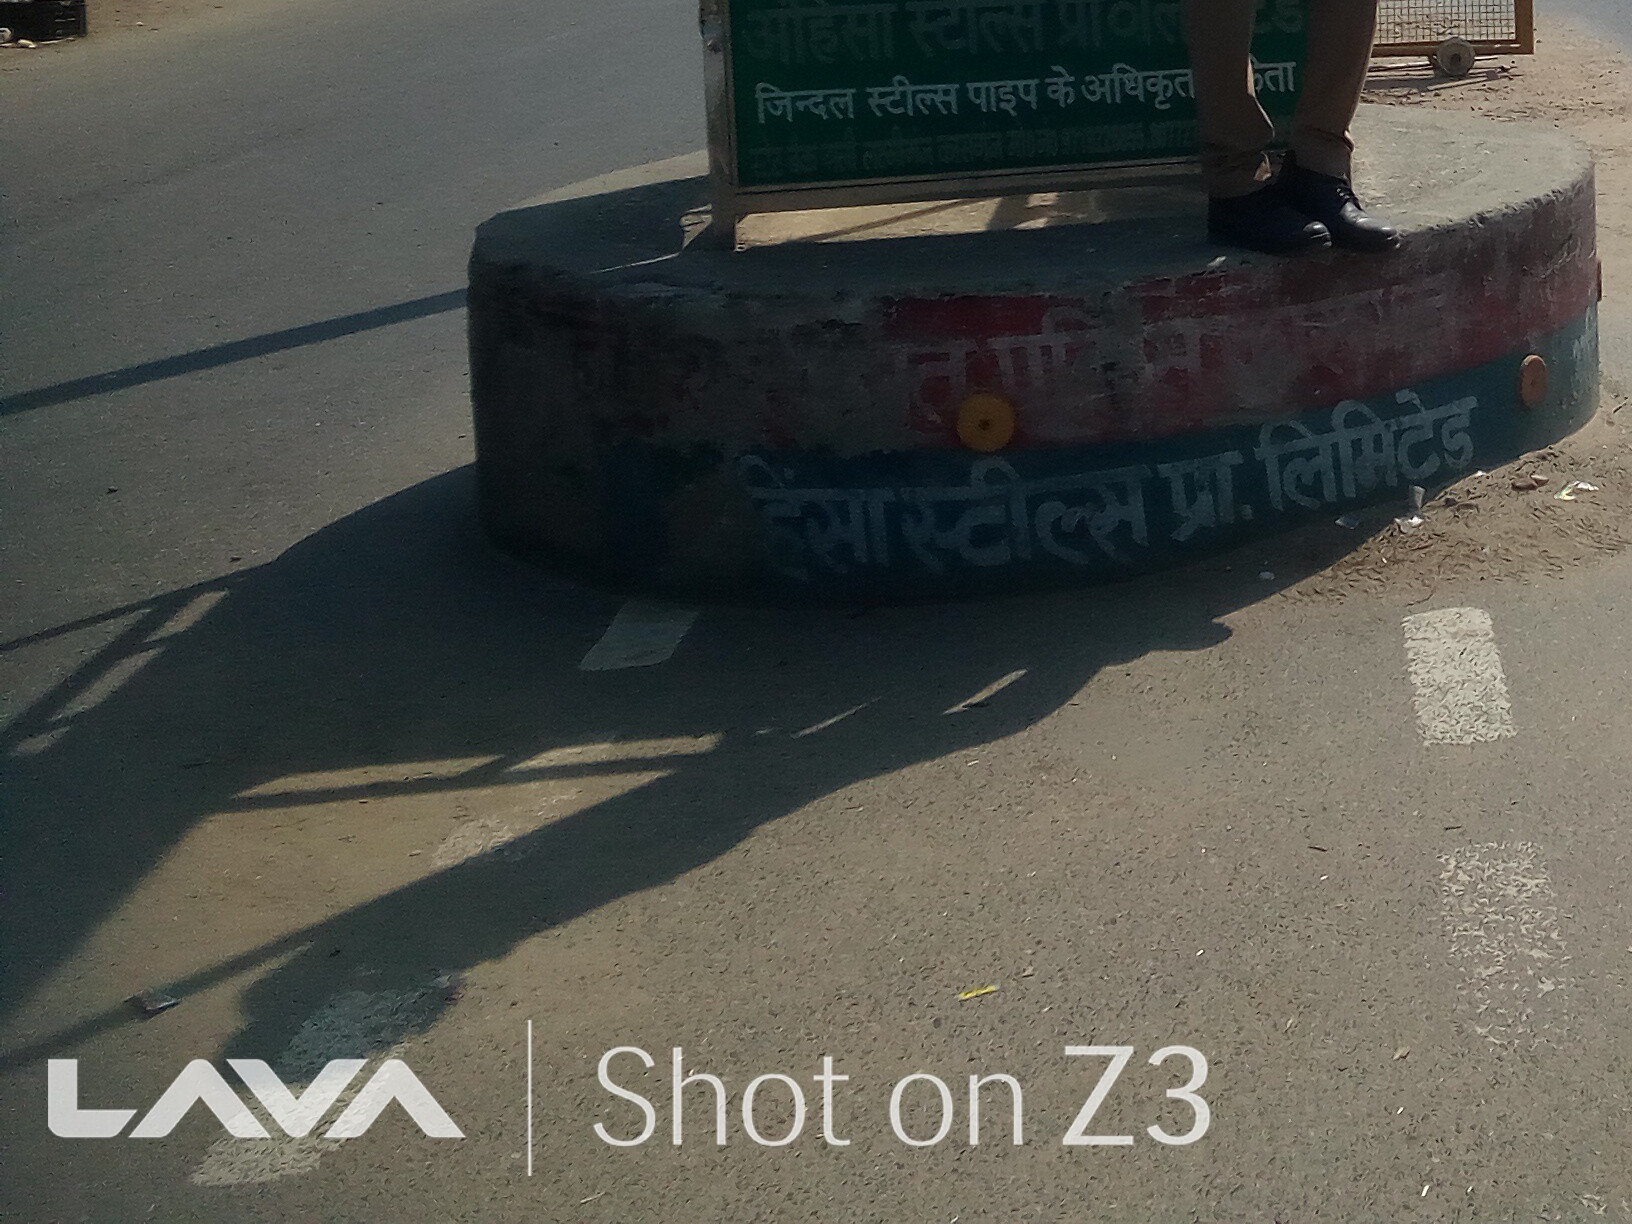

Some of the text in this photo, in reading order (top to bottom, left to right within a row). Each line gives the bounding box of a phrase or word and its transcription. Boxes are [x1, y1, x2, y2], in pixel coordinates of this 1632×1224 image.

[754, 80, 857, 125] जिन्दल
[865, 74, 961, 119] स्टील्स
[964, 78, 1040, 119] पाइप
[1044, 63, 1078, 110] के
[1080, 63, 1196, 111] अधिकृत
[898, 456, 1151, 574] स्टील्स
[1157, 451, 1258, 542] प्रा.
[1257, 387, 1481, 516] लिमिटेड
